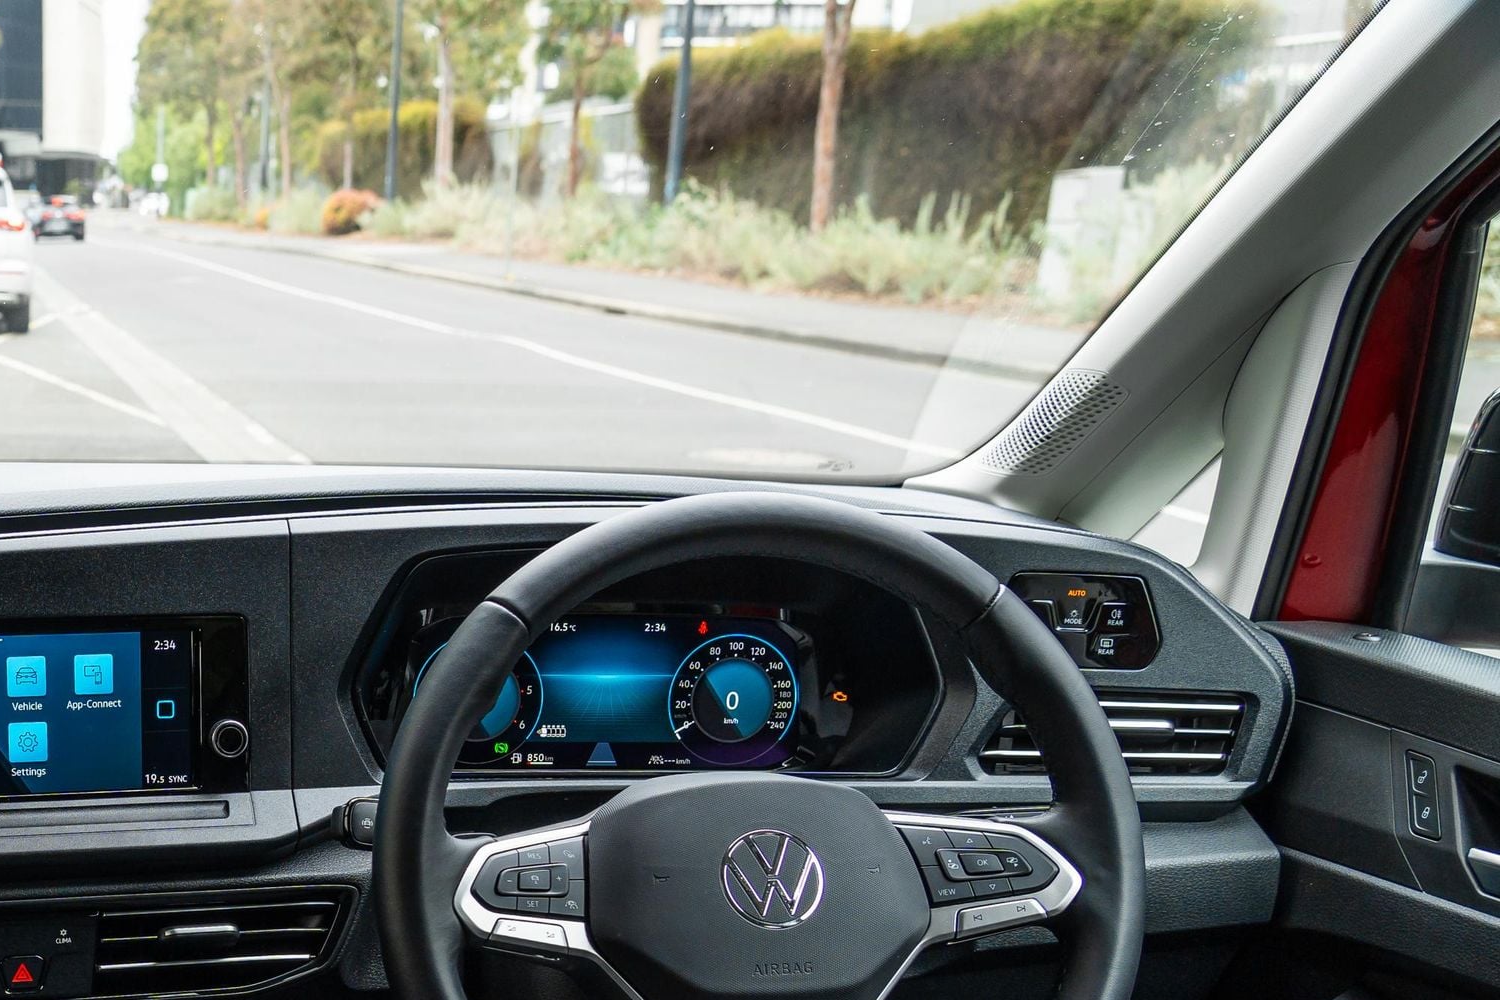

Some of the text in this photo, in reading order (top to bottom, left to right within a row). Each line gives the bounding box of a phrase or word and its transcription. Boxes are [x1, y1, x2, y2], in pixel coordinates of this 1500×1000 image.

[1067, 589, 1087, 597] AUTO
[550, 622, 568, 632] 16.5
[644, 623, 666, 632] 2:34
[154, 640, 176, 650] 2:34
[729, 642, 744, 650] 100
[709, 647, 721, 655] 80
[751, 647, 766, 656] 120
[689, 661, 701, 670] 60
[769, 662, 784, 670] 140
[678, 680, 690, 688] 40
[777, 680, 791, 688] 160
[526, 685, 533, 695] 5
[66, 699, 122, 711] App-Connect
[675, 700, 687, 709] 20
[726, 691, 739, 710] 0
[777, 700, 792, 709] 200
[12, 701, 43, 711] Vehicle
[775, 711, 787, 719] 220
[519, 720, 526, 729] 6
[723, 717, 739, 725] km/h
[769, 721, 785, 729] 240
[527, 753, 545, 762] 850
[11, 767, 47, 778] Settings
[145, 774, 188, 784] 19.5 SYNC
[937, 888, 956, 896] VIEW
[526, 900, 539, 908] SET
[55, 937, 72, 945] CLIMA
[754, 961, 814, 976] AIRBAG
